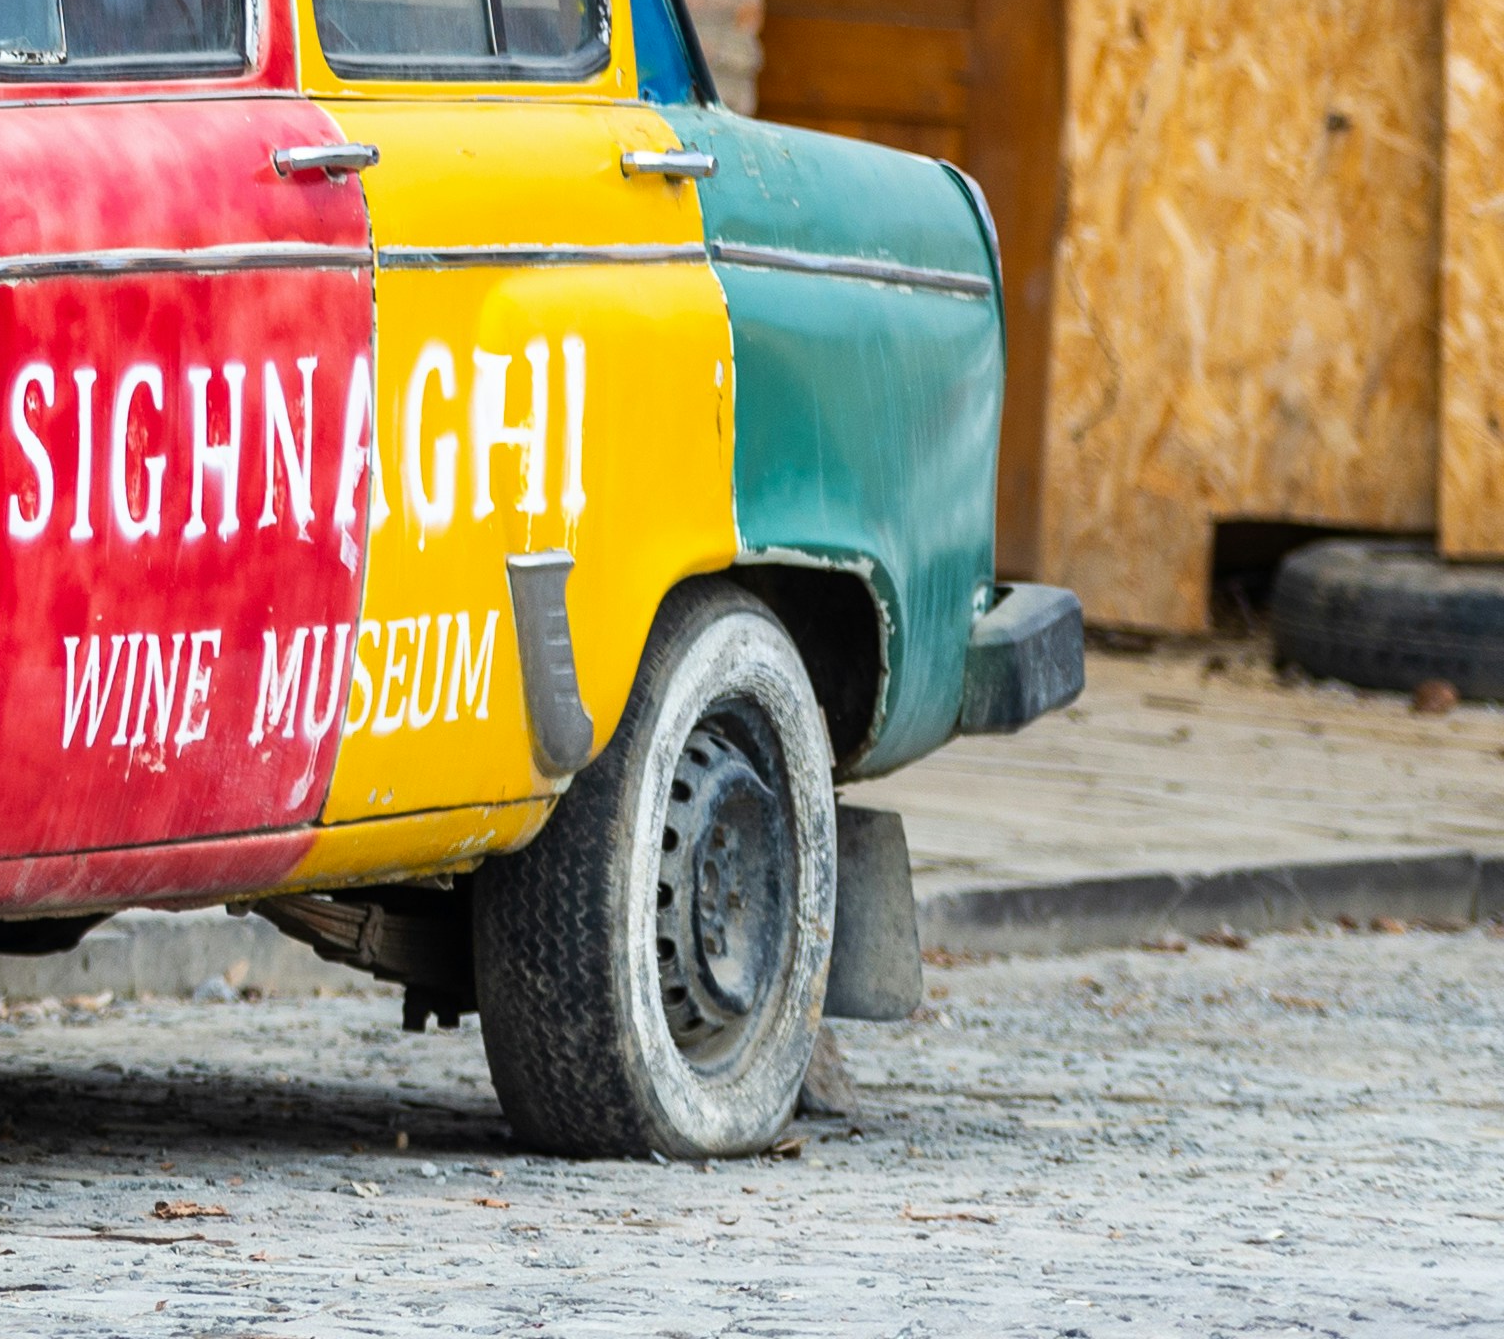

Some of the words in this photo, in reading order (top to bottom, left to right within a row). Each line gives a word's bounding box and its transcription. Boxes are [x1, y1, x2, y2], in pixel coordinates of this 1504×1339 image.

[7, 335, 586, 540] SIGHNAGHI
[61, 629, 221, 751] WINE
[249, 609, 500, 747] MUSEUM
